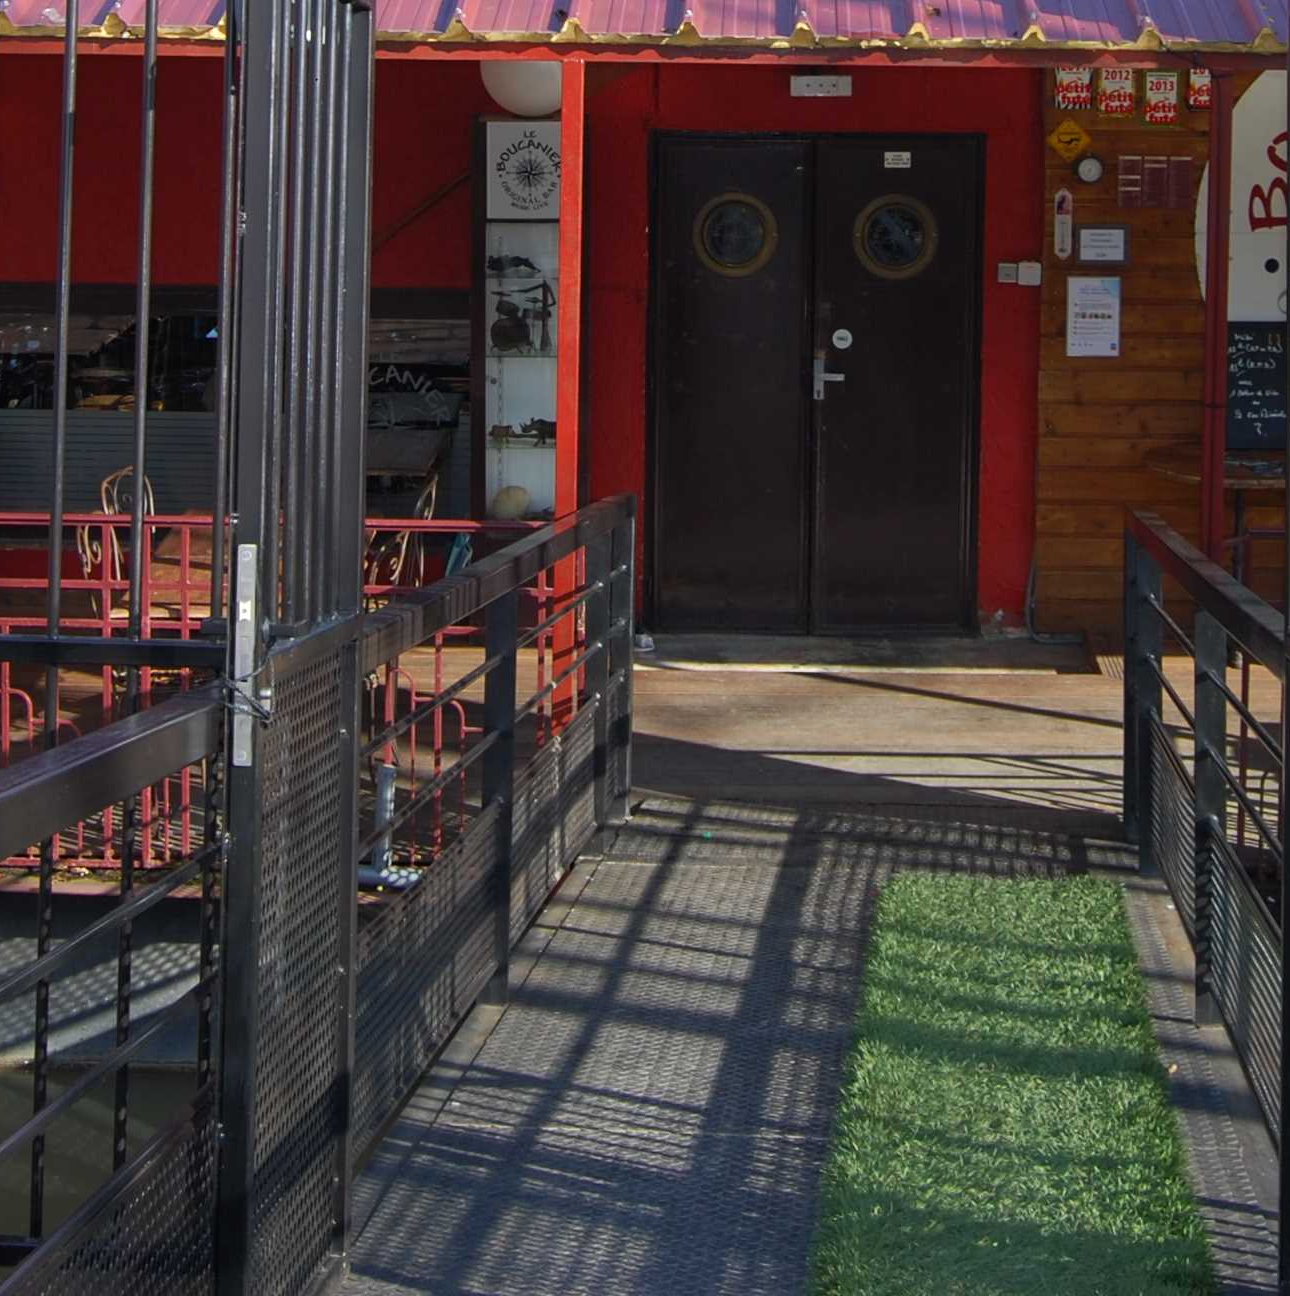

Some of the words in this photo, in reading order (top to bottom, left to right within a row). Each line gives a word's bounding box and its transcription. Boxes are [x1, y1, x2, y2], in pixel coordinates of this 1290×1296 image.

[1104, 70, 1130, 81] 2012
[1148, 80, 1175, 92] 2013
[523, 130, 538, 139] LE
[496, 139, 561, 173] BOUCANIER
